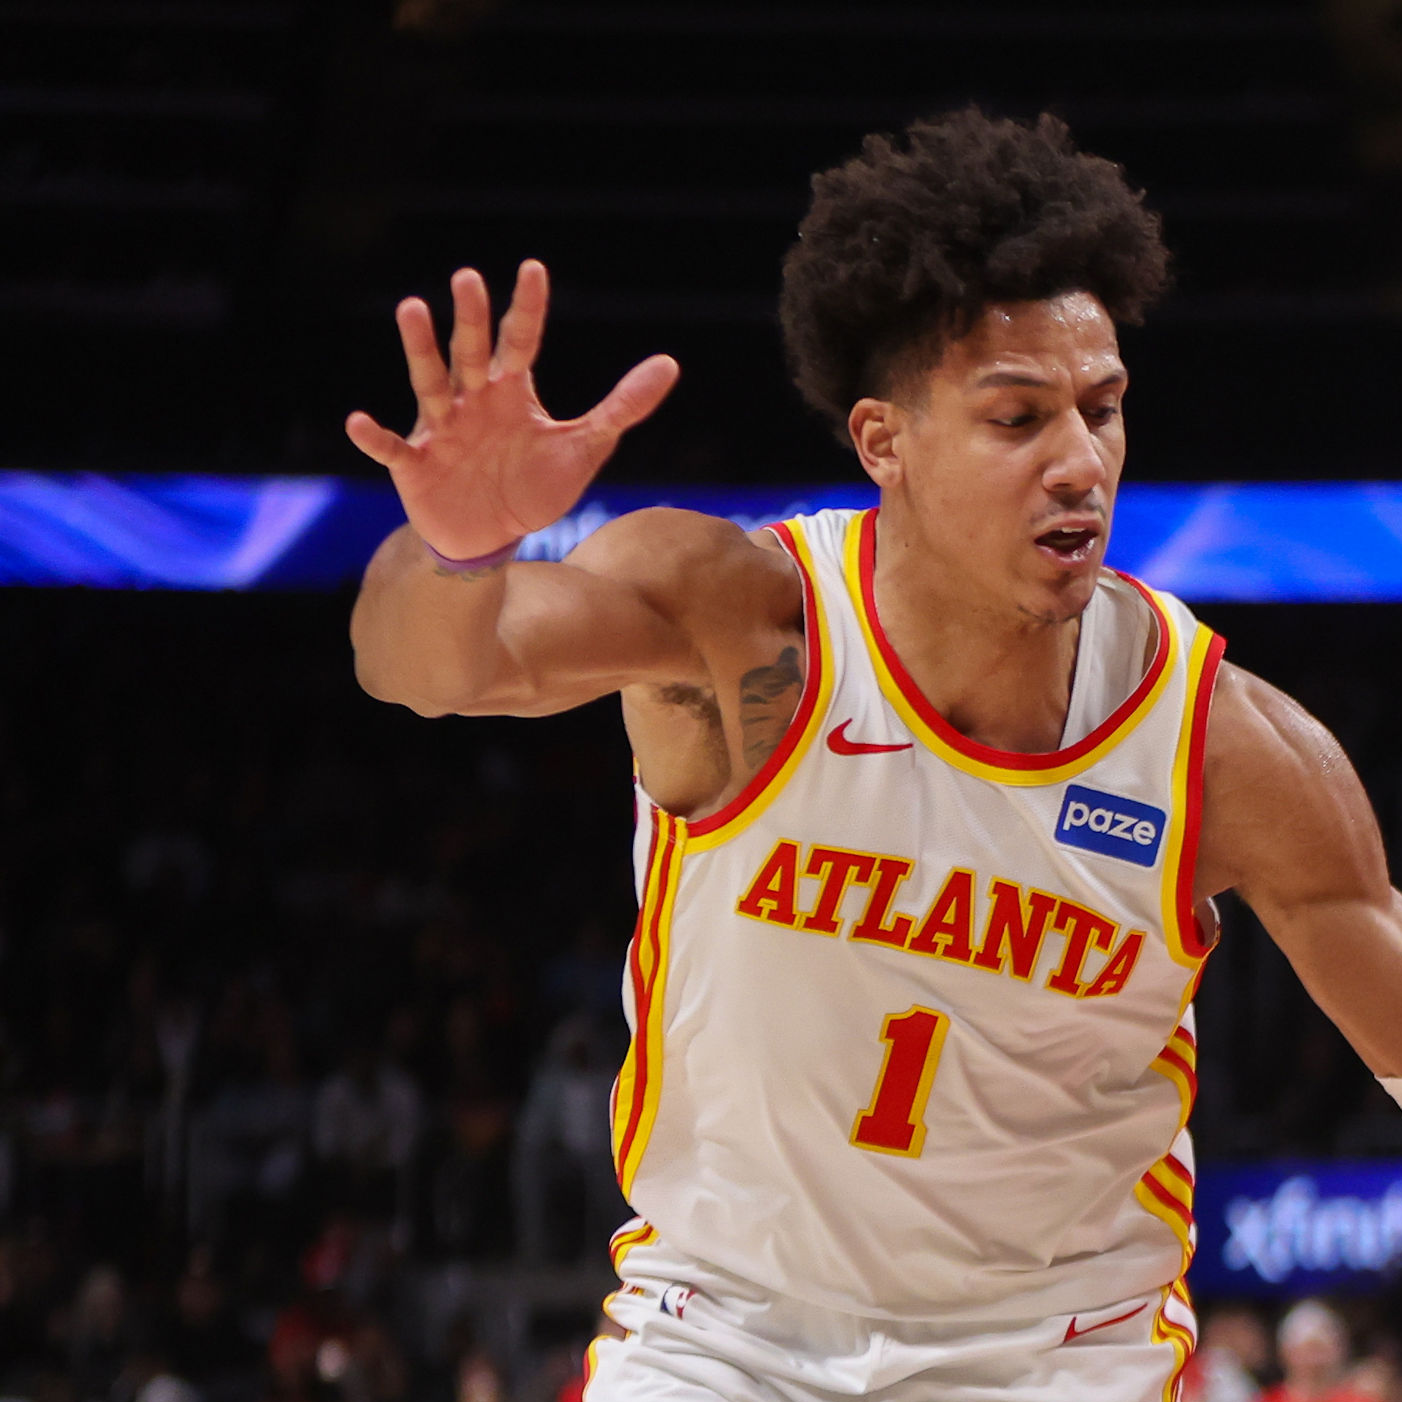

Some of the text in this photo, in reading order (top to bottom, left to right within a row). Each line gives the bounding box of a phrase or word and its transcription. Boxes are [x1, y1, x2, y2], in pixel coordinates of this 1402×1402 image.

[1062, 798, 1157, 847] paze
[736, 838, 1147, 999] ATLANTA
[849, 1004, 950, 1158] 1
